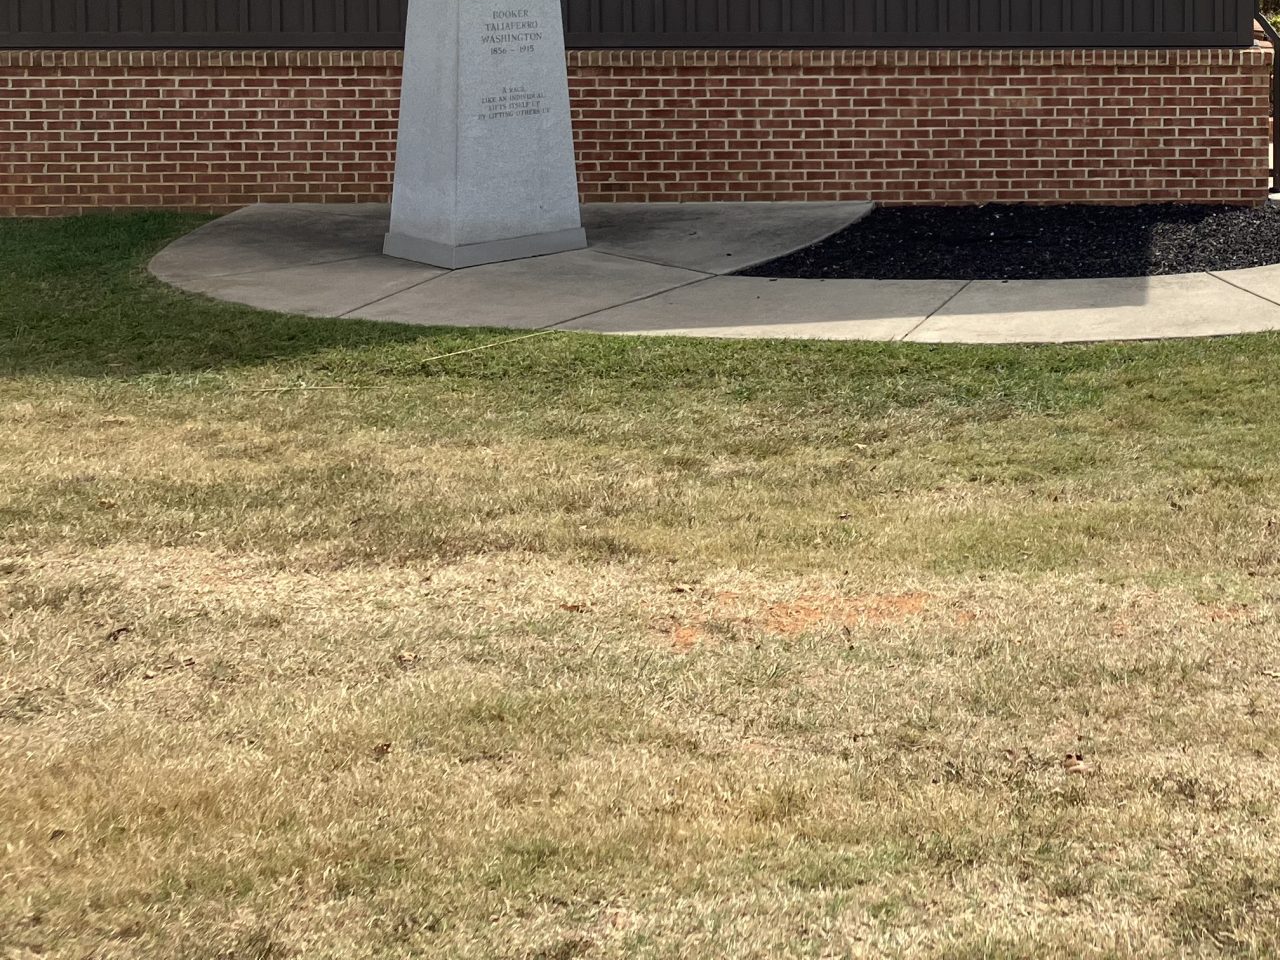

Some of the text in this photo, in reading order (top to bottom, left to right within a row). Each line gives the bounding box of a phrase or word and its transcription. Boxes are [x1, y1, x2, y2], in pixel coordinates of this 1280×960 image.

[493, 10, 529, 19] BOOKER
[485, 21, 538, 31] TALIAFERRO
[481, 32, 542, 43] WASHINGTON
